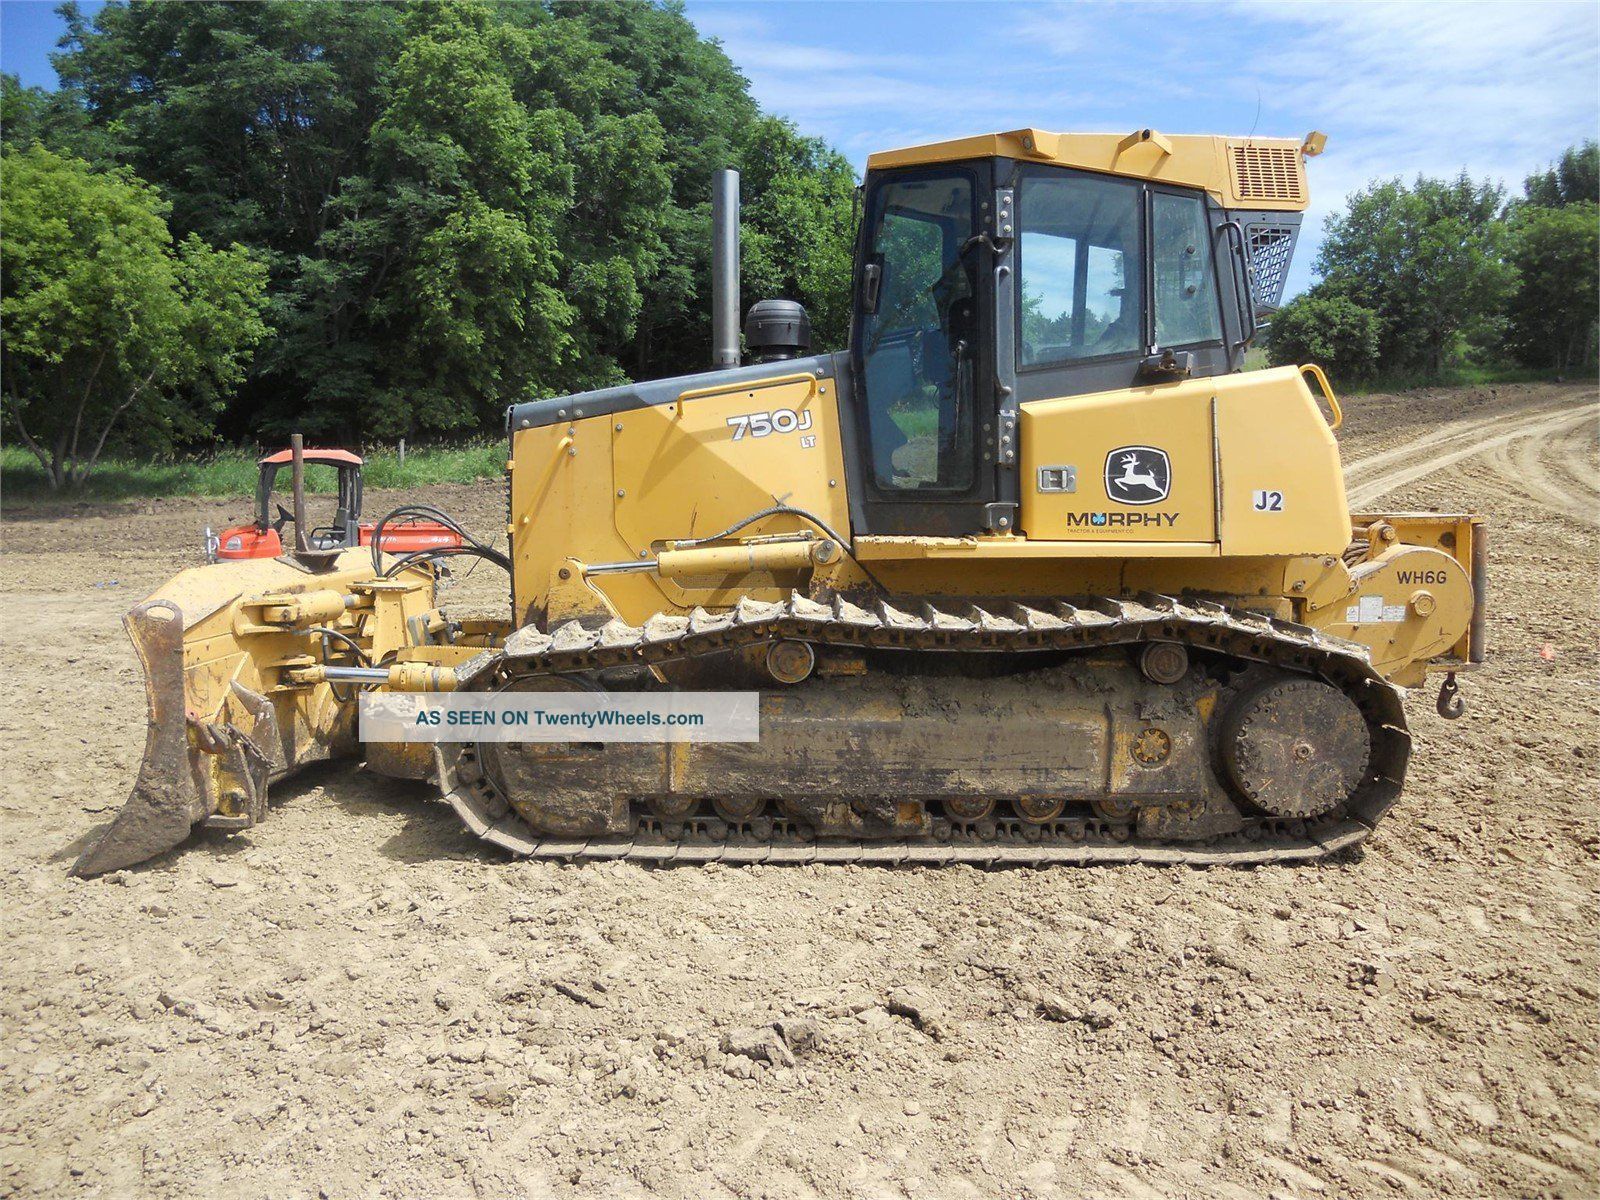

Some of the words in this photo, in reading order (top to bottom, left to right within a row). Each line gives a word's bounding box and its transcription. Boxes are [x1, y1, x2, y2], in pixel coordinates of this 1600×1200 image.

[726, 408, 813, 441] 750J
[800, 435, 816, 449] LT
[1254, 490, 1282, 512] J2
[1066, 512, 1180, 527] MURPHY
[1396, 570, 1447, 584] WH6G
